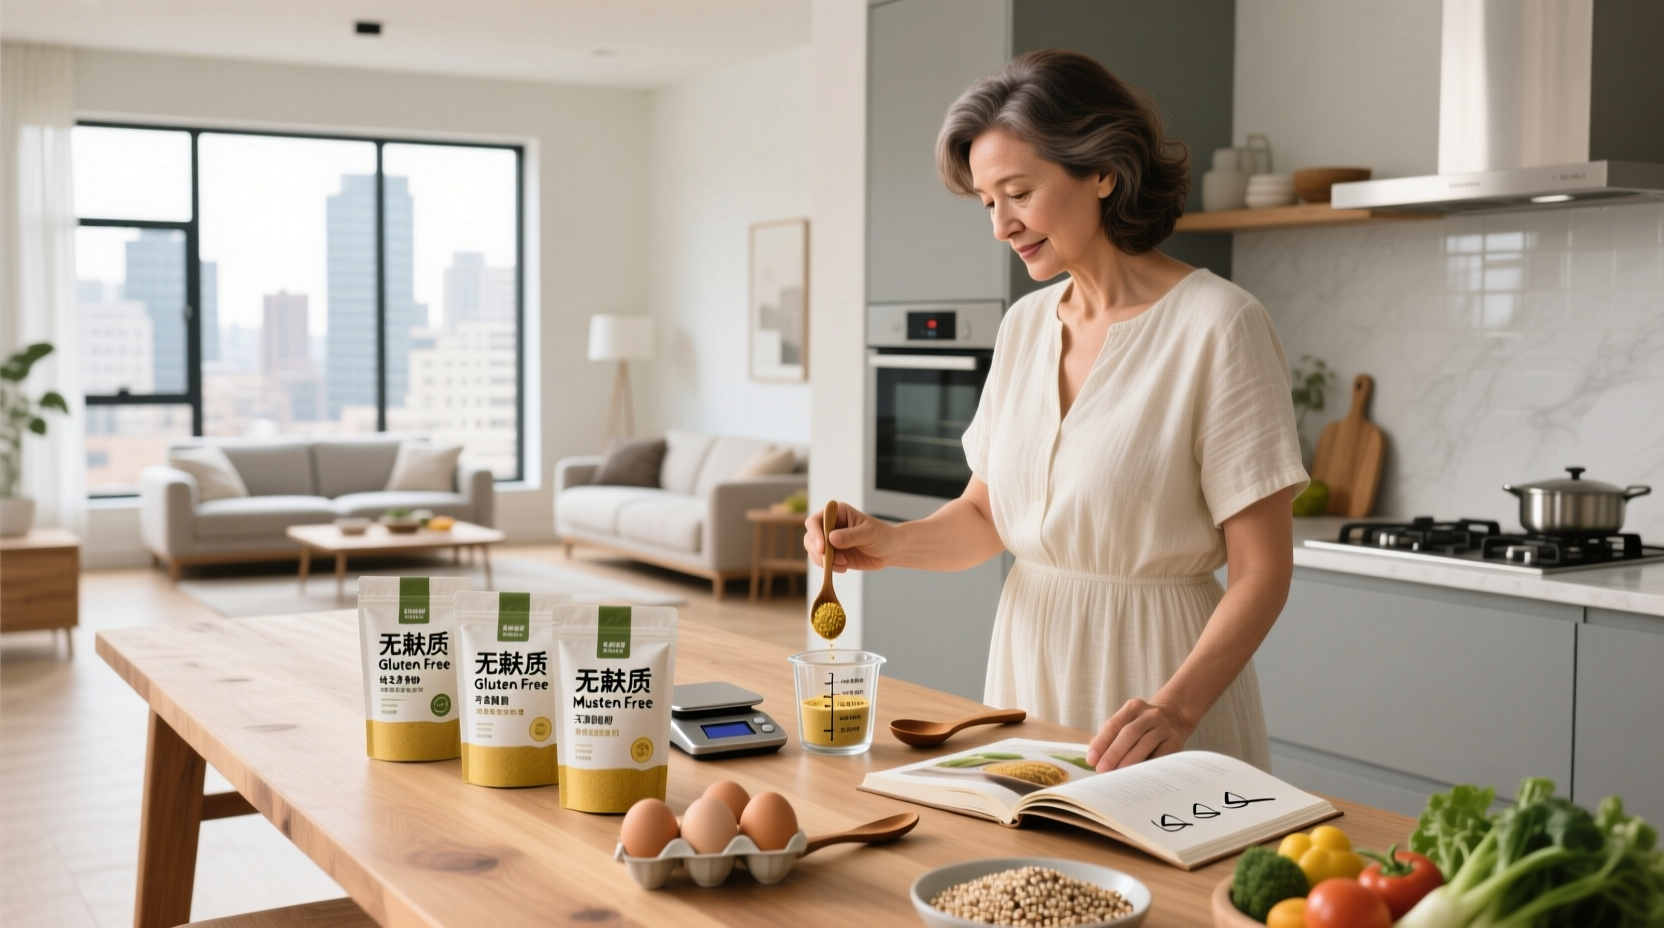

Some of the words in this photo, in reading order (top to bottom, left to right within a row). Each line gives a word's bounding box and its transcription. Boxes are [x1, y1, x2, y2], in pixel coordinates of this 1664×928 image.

[378, 658, 421, 671] Gluten
[424, 658, 451, 671] Free
[474, 677, 518, 690] Gluten
[521, 678, 549, 691] Free
[573, 695, 621, 709] Musten
[624, 696, 654, 709] Free
